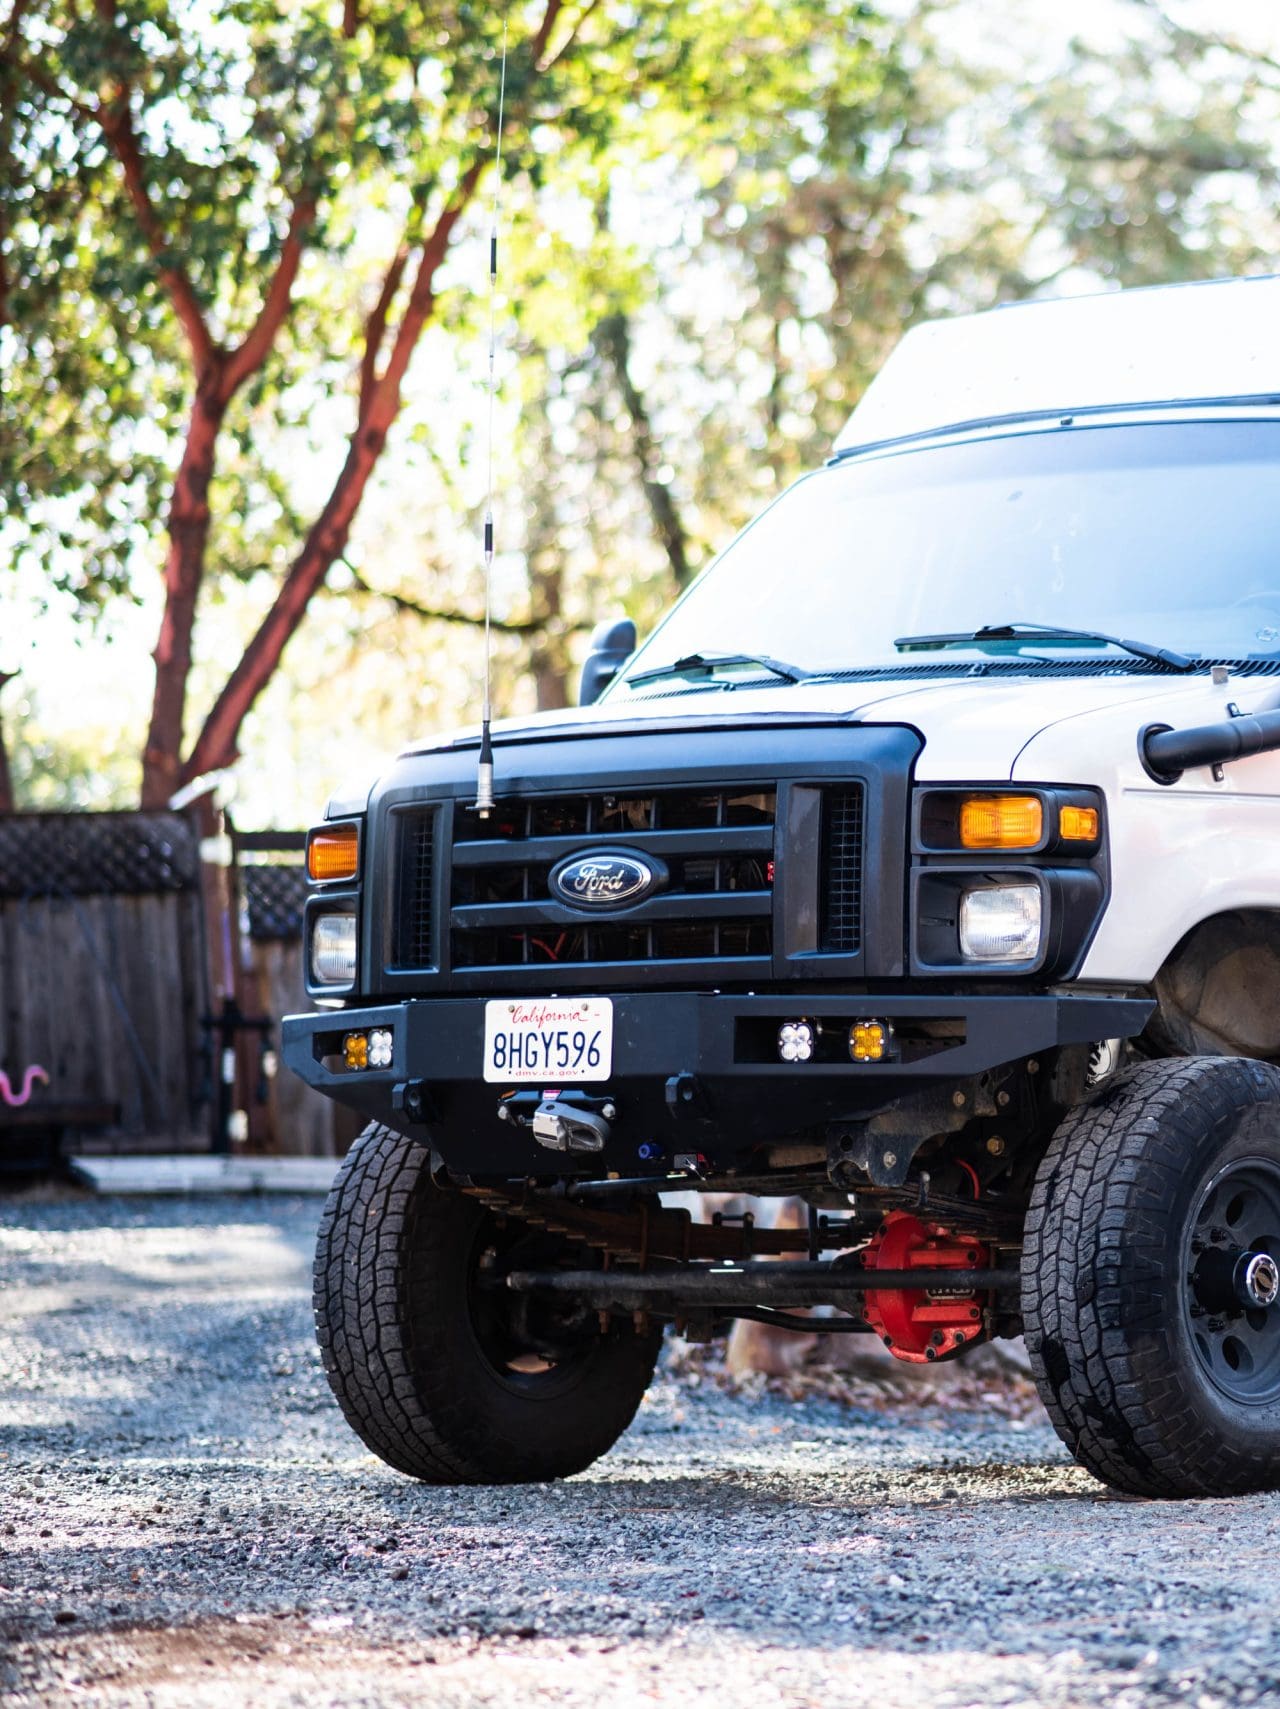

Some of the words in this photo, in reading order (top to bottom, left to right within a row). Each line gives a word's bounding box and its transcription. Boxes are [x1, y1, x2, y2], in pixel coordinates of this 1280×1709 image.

[574, 863, 625, 891] Ford
[512, 1005, 589, 1028] California
[493, 1030, 602, 1069] 8HGY596
[515, 1069, 579, 1077] dmv.ca.gov
